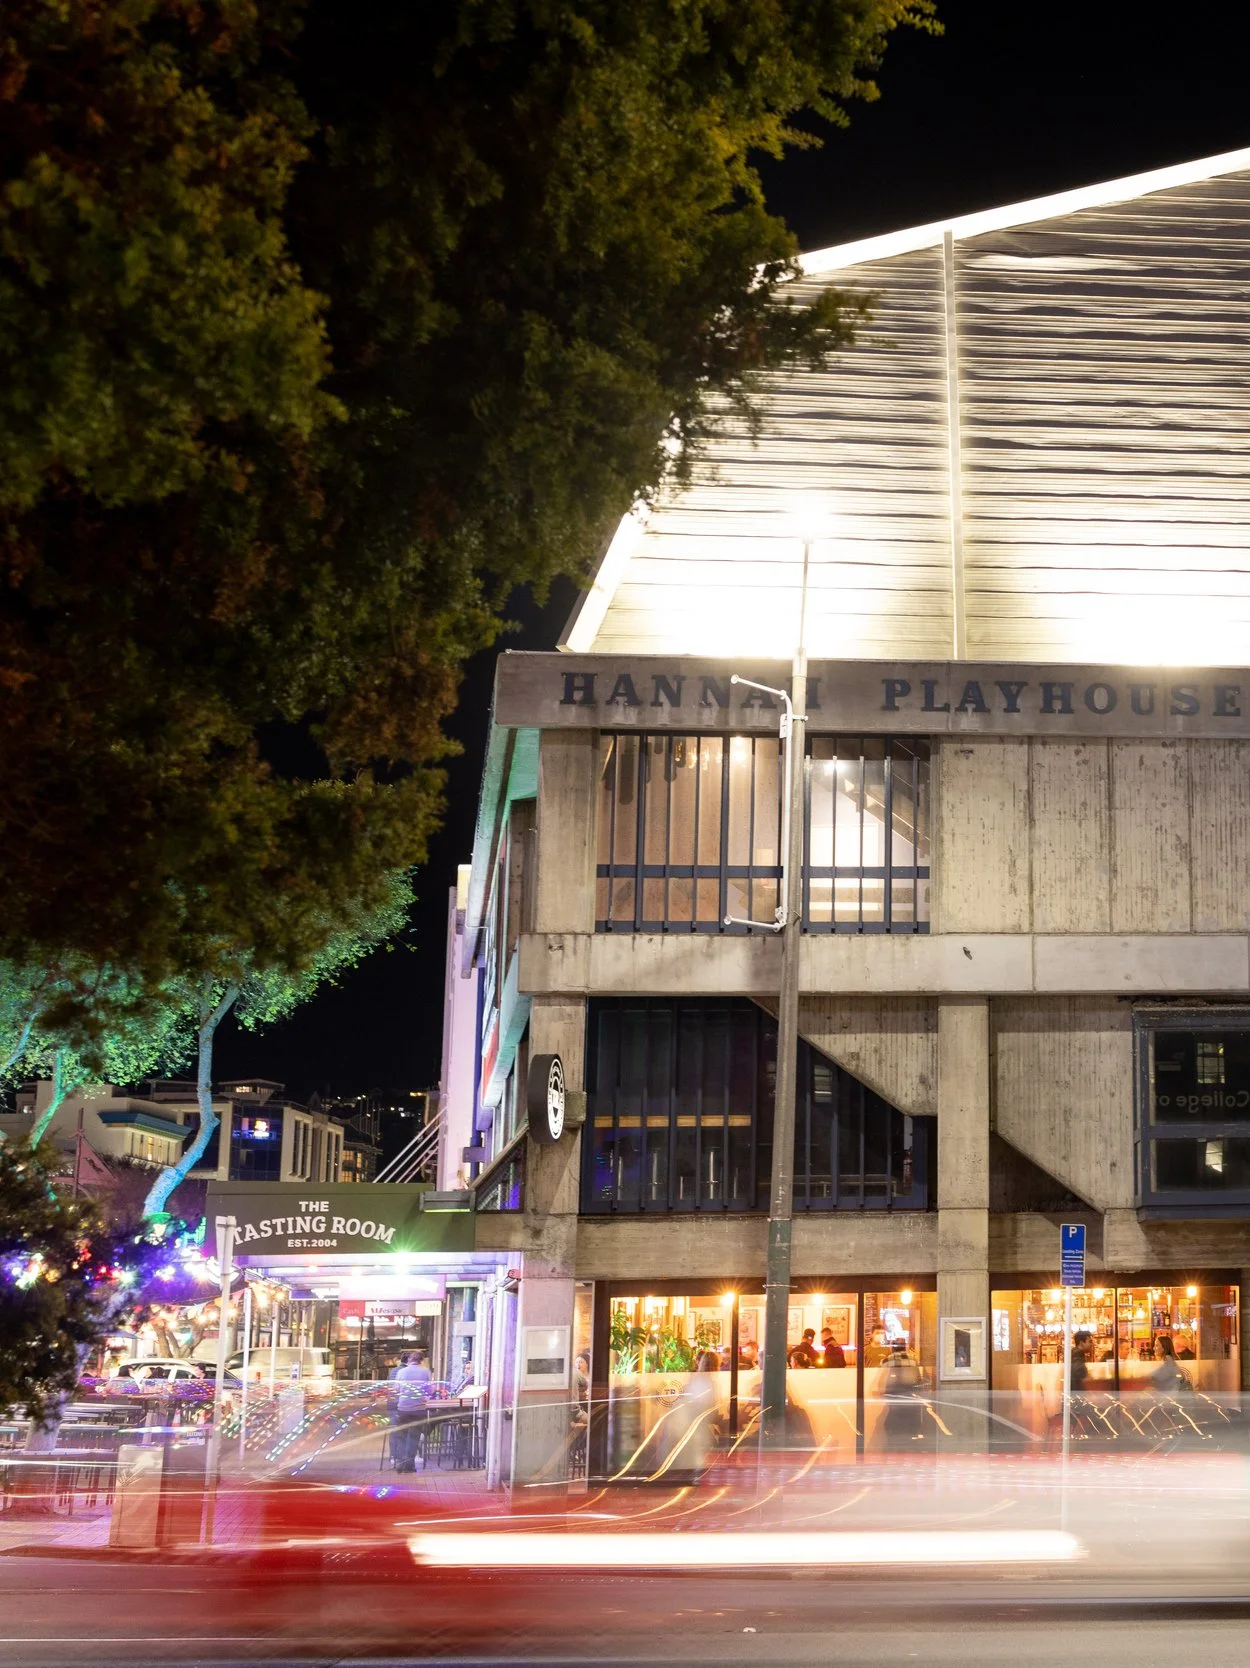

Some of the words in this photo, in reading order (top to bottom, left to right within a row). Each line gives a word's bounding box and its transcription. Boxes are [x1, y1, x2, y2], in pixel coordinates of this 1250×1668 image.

[881, 678, 1243, 717] PLAYHOUSE
[299, 1201, 329, 1212] THE
[234, 1216, 327, 1246] TASTING
[331, 1216, 397, 1245] ROOM
[1069, 1226, 1077, 1238] P
